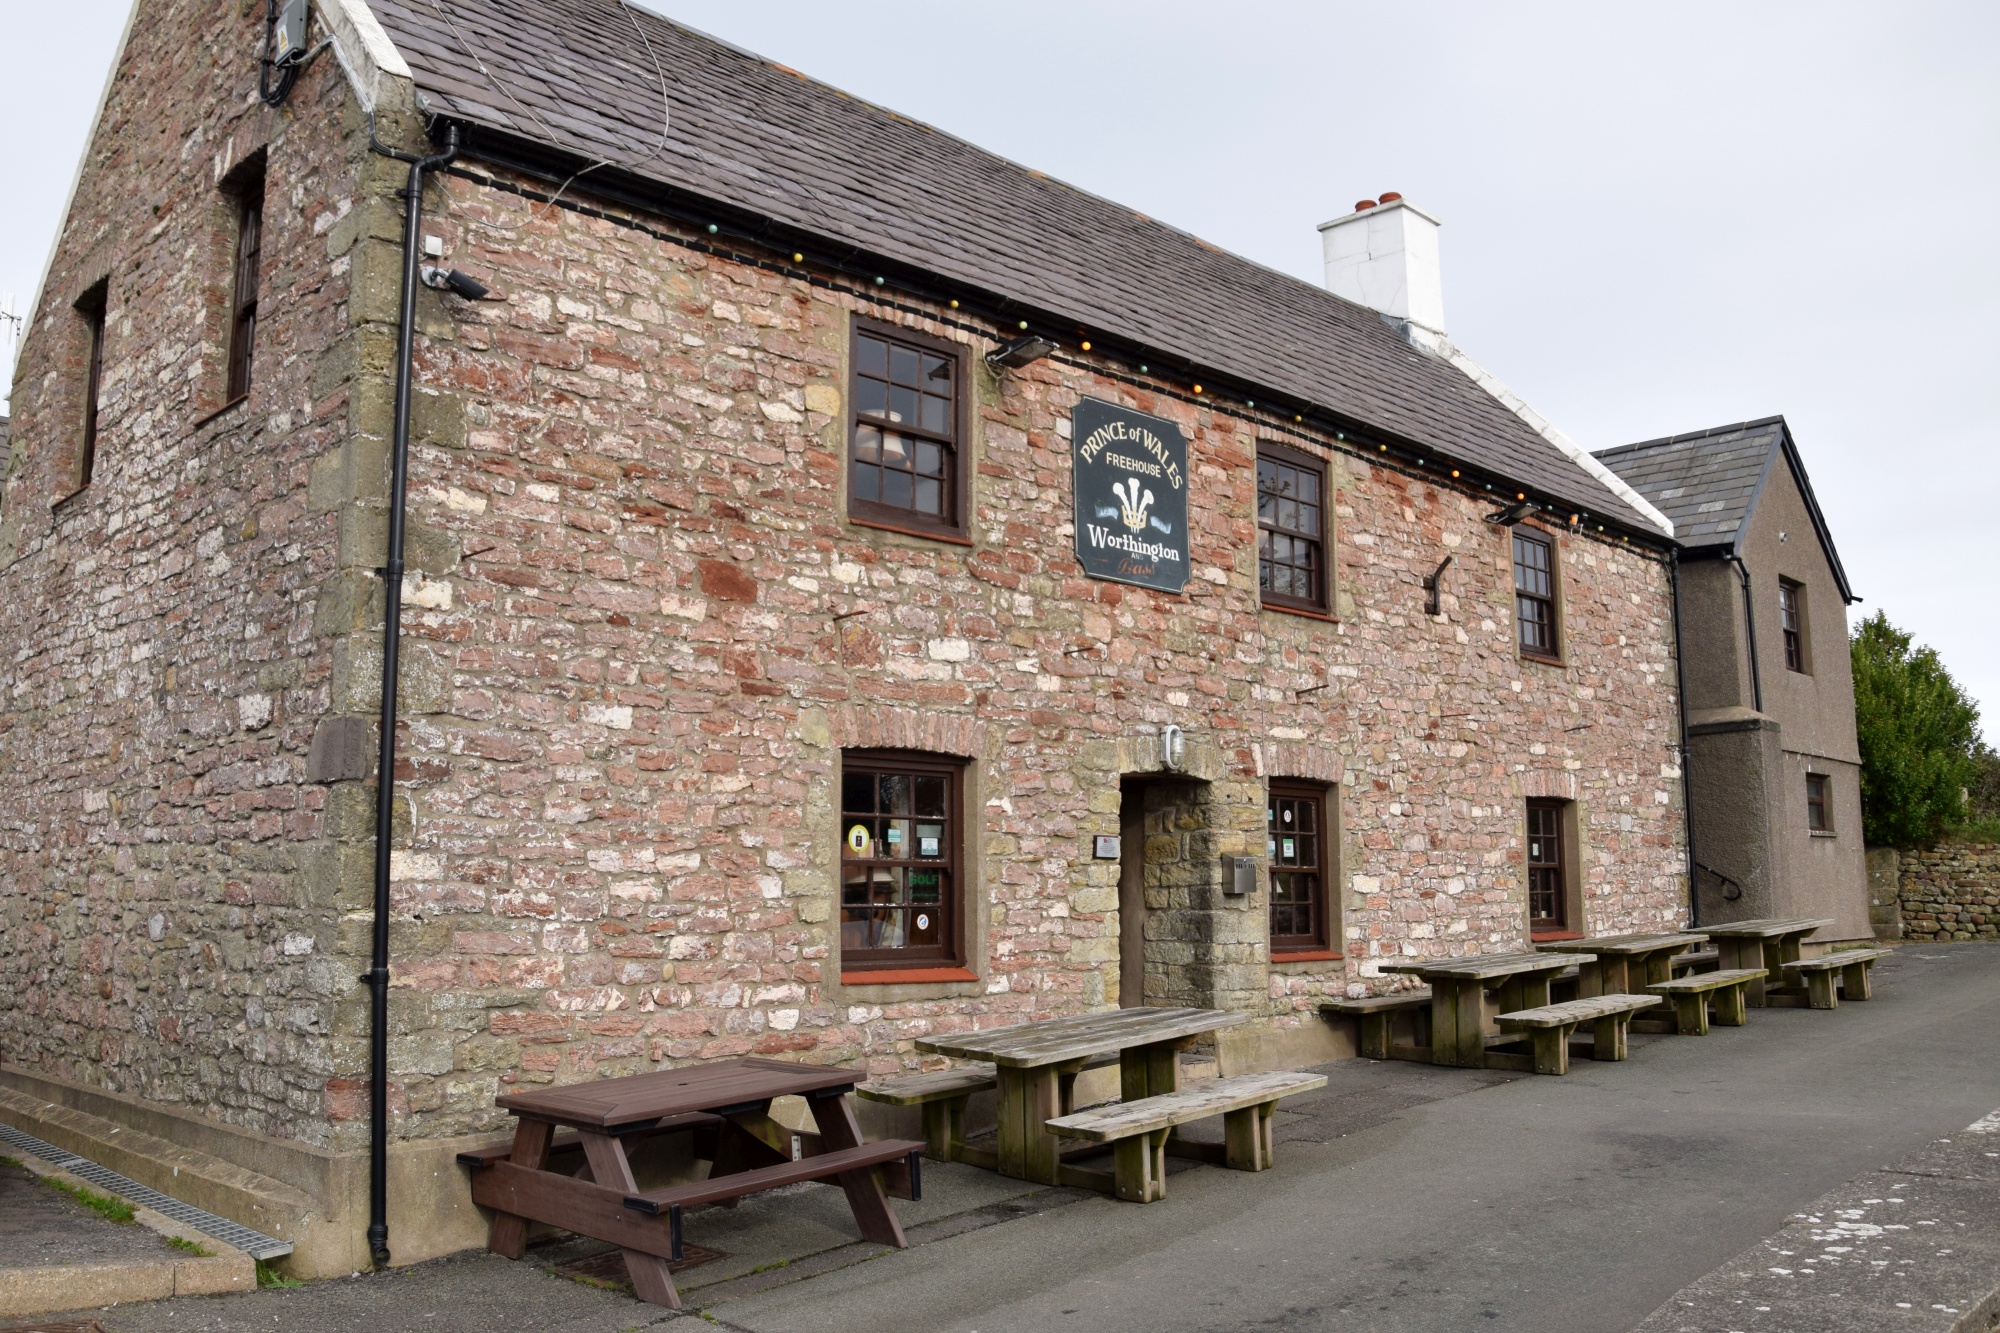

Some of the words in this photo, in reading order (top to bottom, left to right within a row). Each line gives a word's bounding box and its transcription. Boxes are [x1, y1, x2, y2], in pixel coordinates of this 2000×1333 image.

[1080, 422, 1127, 464] PRINCE
[1129, 427, 1142, 443] of
[1143, 428, 1183, 490] WALES
[1106, 452, 1161, 478] FREEHOUSE
[1087, 524, 1180, 562] Worthington
[909, 874, 938, 885] GOLF
